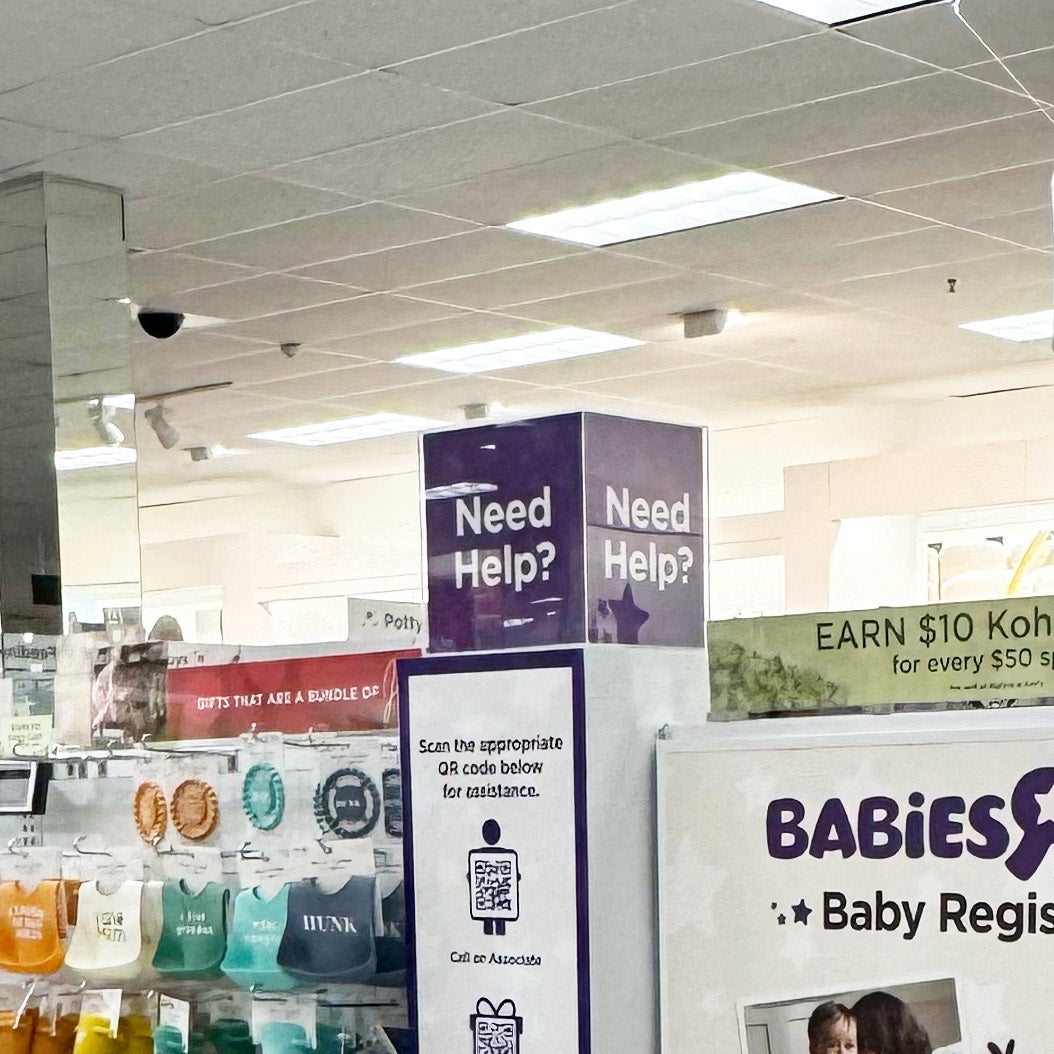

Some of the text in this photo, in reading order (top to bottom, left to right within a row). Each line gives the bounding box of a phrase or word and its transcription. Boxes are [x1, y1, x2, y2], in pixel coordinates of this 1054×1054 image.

[456, 486, 552, 536] Need
[606, 485, 690, 533] Need
[454, 541, 556, 592] Help?
[604, 539, 694, 591] Help?
[817, 617, 906, 650] EARN
[919, 612, 974, 648] $10
[893, 654, 921, 675] for
[928, 652, 984, 674] every
[991, 648, 1033, 672] $50
[234, 693, 263, 709] THAT
[295, 690, 305, 703] A
[419, 735, 563, 754] Scan the appropriate
[438, 759, 544, 776] QR code below
[443, 784, 462, 799] for
[303, 914, 357, 933] HUNK
[823, 890, 926, 941] Baby
